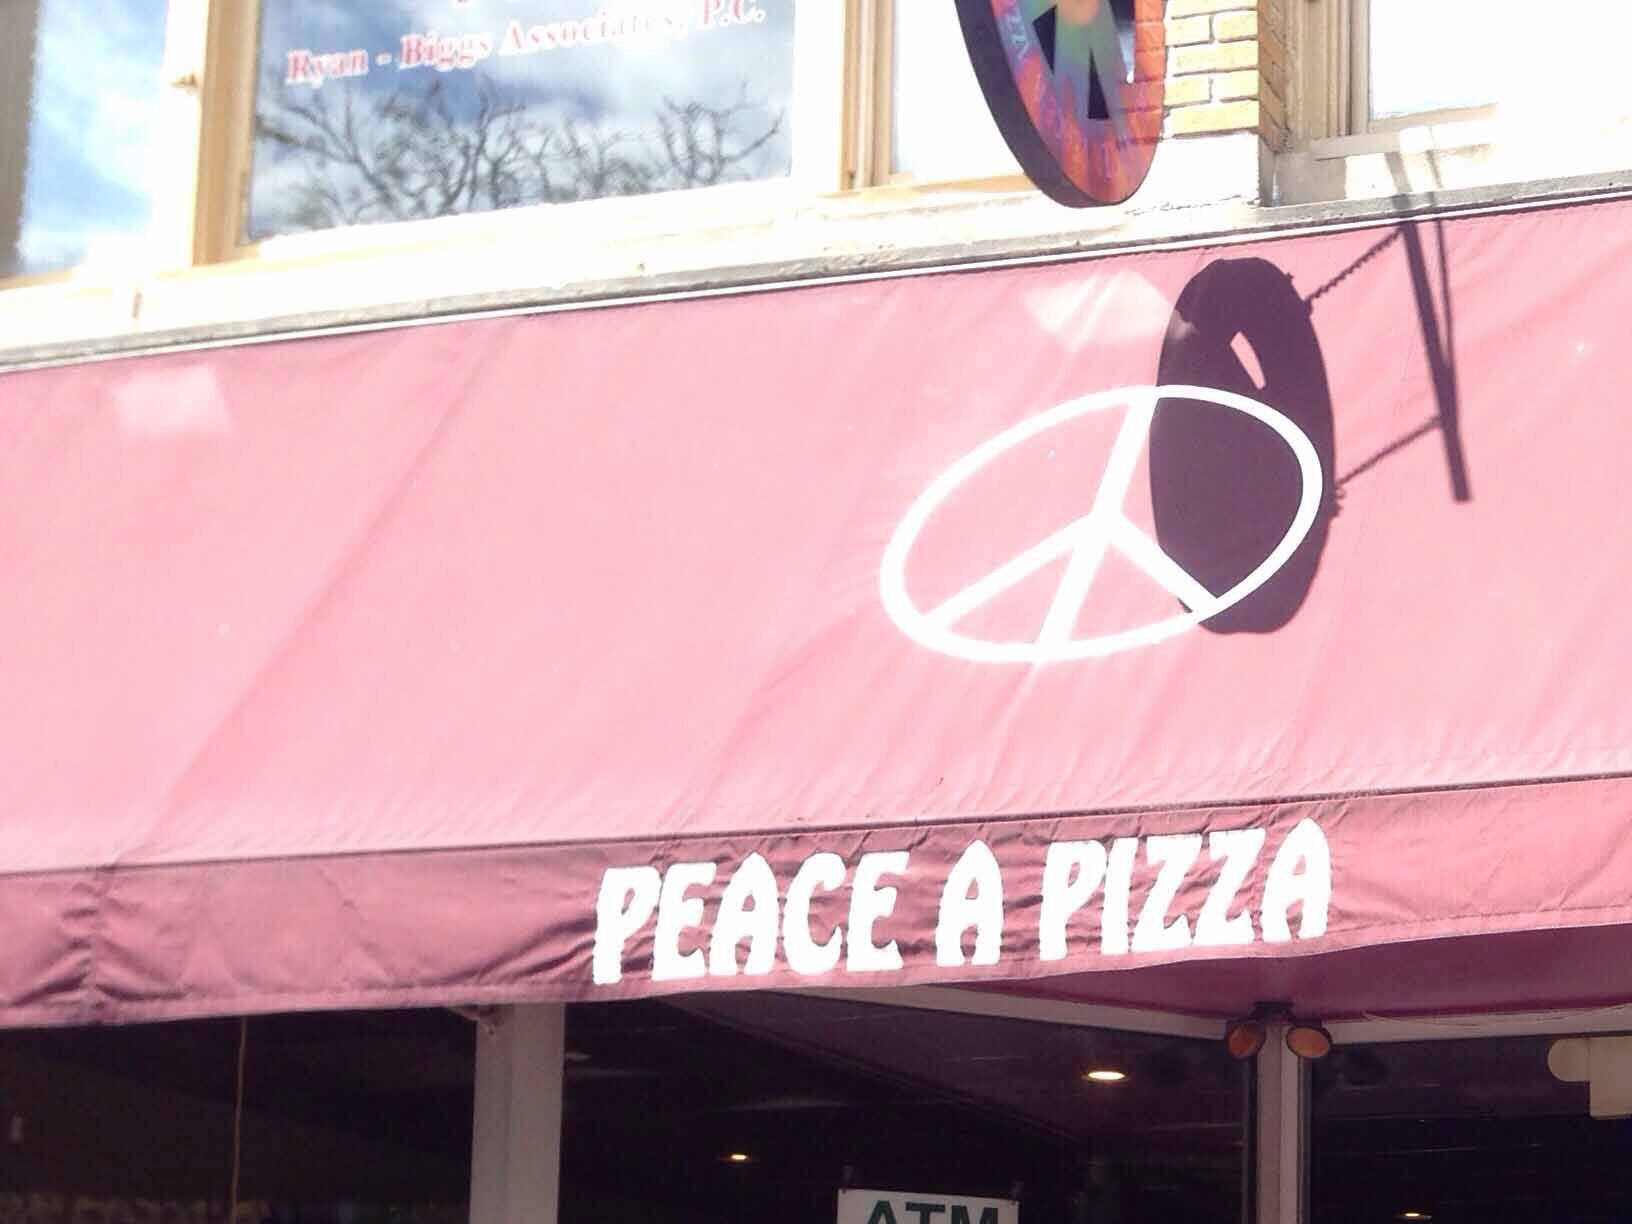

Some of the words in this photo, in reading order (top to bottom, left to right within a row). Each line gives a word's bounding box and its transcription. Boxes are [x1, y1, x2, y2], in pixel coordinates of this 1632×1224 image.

[286, 49, 368, 88] Ryan
[399, 33, 491, 71] Biggs
[593, 850, 910, 984] PEACE
[935, 840, 1004, 967] A
[1039, 818, 1333, 961] PIZZA
